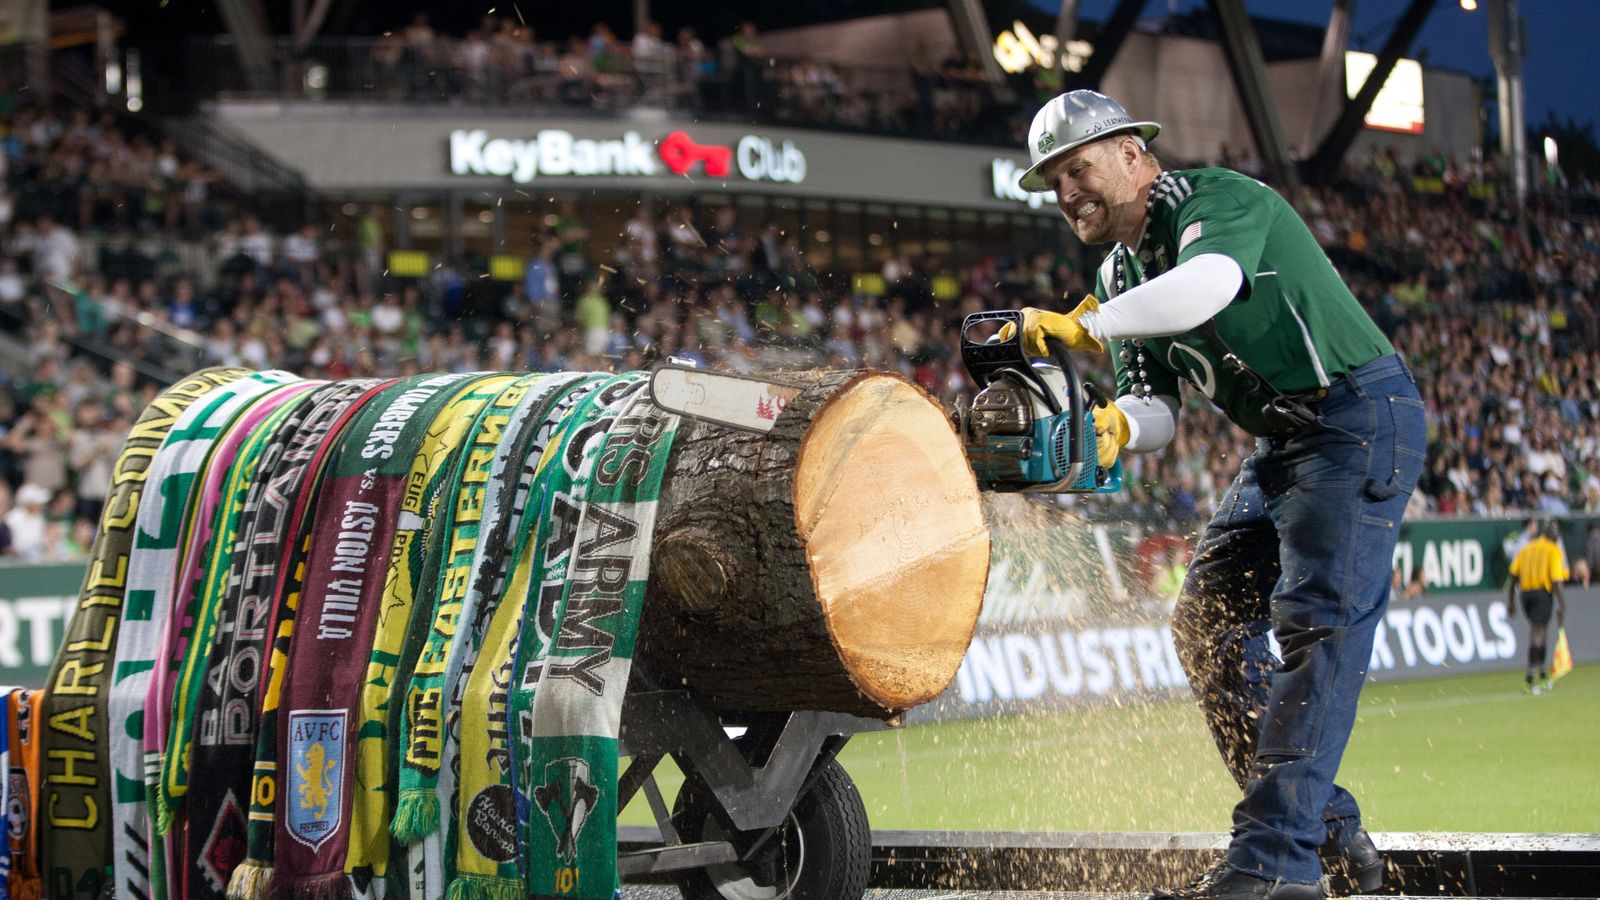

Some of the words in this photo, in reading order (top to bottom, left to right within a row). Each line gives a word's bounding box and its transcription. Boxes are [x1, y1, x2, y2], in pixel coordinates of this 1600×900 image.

[449, 129, 656, 183] KeyBank
[737, 134, 807, 184] Club
[405, 472, 425, 508] EUG
[331, 501, 380, 573] ASTON
[414, 415, 510, 678] EASTERN
[316, 577, 363, 640] VILLA
[547, 502, 640, 697] ARMY
[1386, 601, 1517, 668] TOOLS
[48, 556, 128, 829] CHARLIE
[294, 721, 340, 743] AVFC
